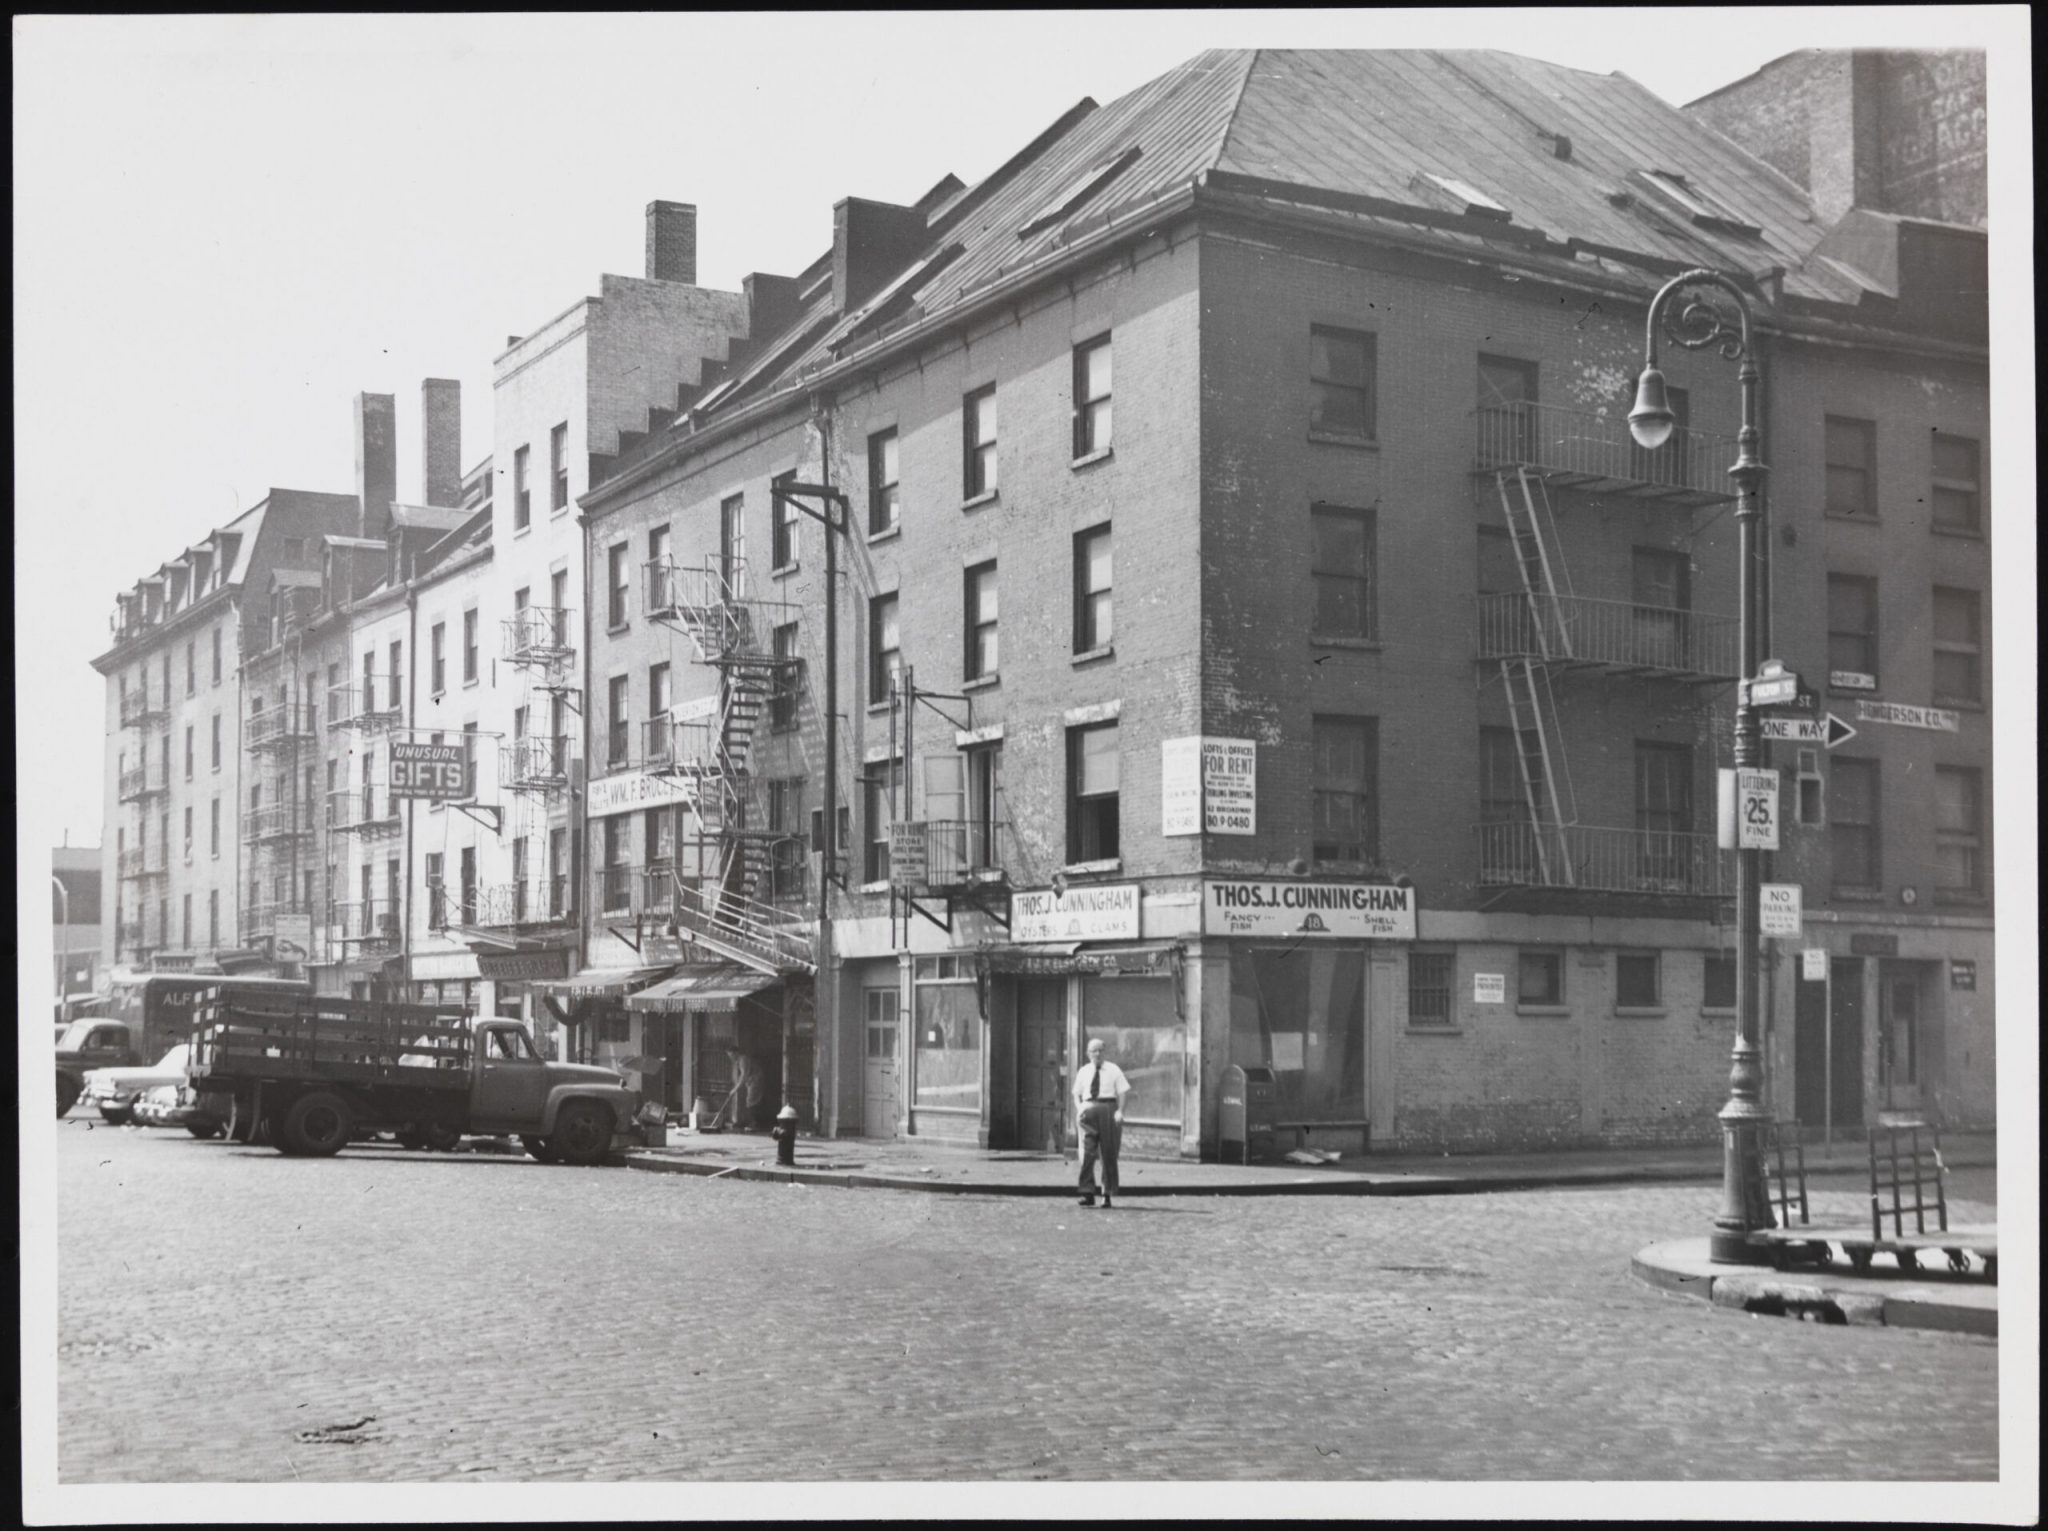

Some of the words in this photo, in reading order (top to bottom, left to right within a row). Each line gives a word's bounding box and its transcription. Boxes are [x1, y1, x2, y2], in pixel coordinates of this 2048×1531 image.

[1763, 721, 1789, 737] ONE
[1799, 722, 1826, 738] WAY
[396, 746, 458, 761] UNUSUAL
[1203, 743, 1222, 755] LOFTS
[1228, 745, 1253, 757] OFFICES
[1203, 754, 1224, 773] FOR
[1227, 756, 1252, 775] RENT
[391, 761, 462, 788] GIFTS
[1742, 775, 1777, 792] LITTERING
[1226, 815, 1251, 829] 0480
[1746, 826, 1771, 837] FINE
[896, 837, 921, 846] STORE
[1055, 889, 1133, 913] CUNNINGHAM
[1213, 885, 1266, 907] THOS.
[1283, 887, 1407, 910] CUNNINGHAM
[1769, 890, 1791, 902] NO
[1763, 903, 1798, 914] PARKING
[1223, 911, 1261, 923] FANCY
[1307, 915, 1321, 930] 18
[1364, 914, 1397, 927] SHELL
[1020, 924, 1058, 938] OYSTERS
[1090, 920, 1128, 934] CLAMS
[1230, 923, 1252, 934] FISH
[1372, 924, 1394, 935] FISH
